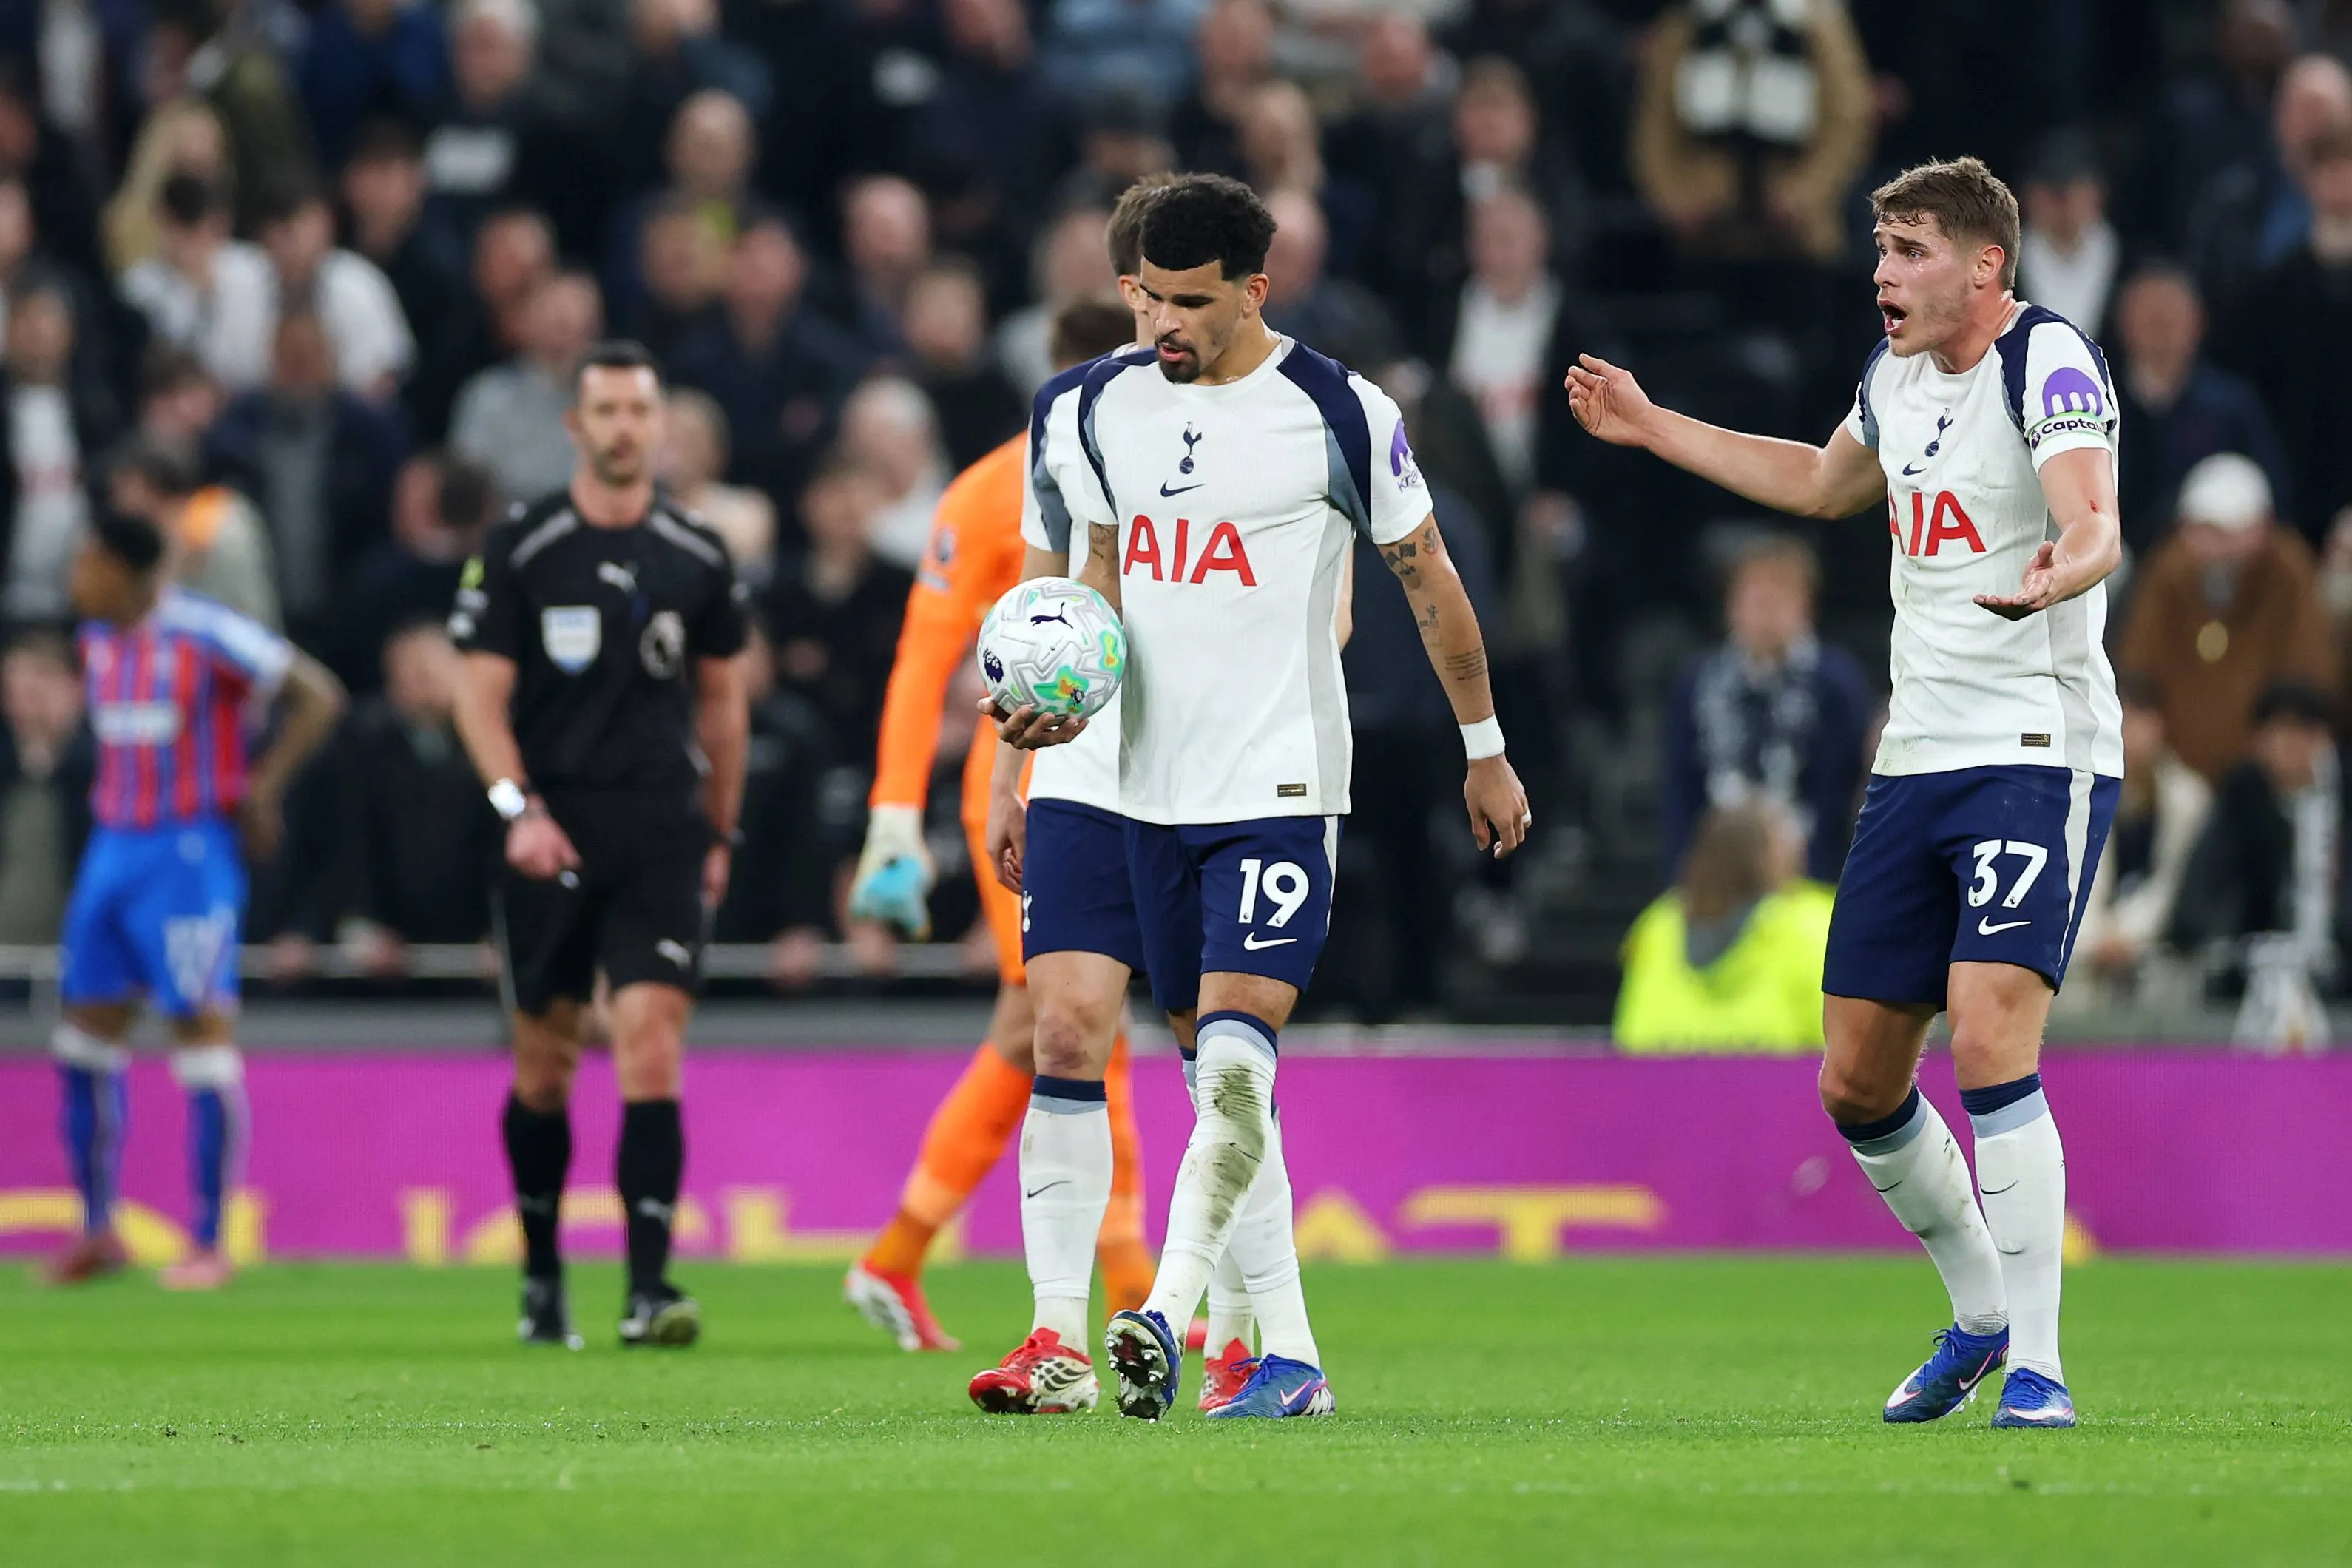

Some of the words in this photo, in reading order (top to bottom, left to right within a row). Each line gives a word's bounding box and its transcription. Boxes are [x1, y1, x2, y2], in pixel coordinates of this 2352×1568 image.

[1123, 514, 1257, 587] AIA
[1238, 859, 1309, 928] 19
[1967, 839, 2048, 908] 37
